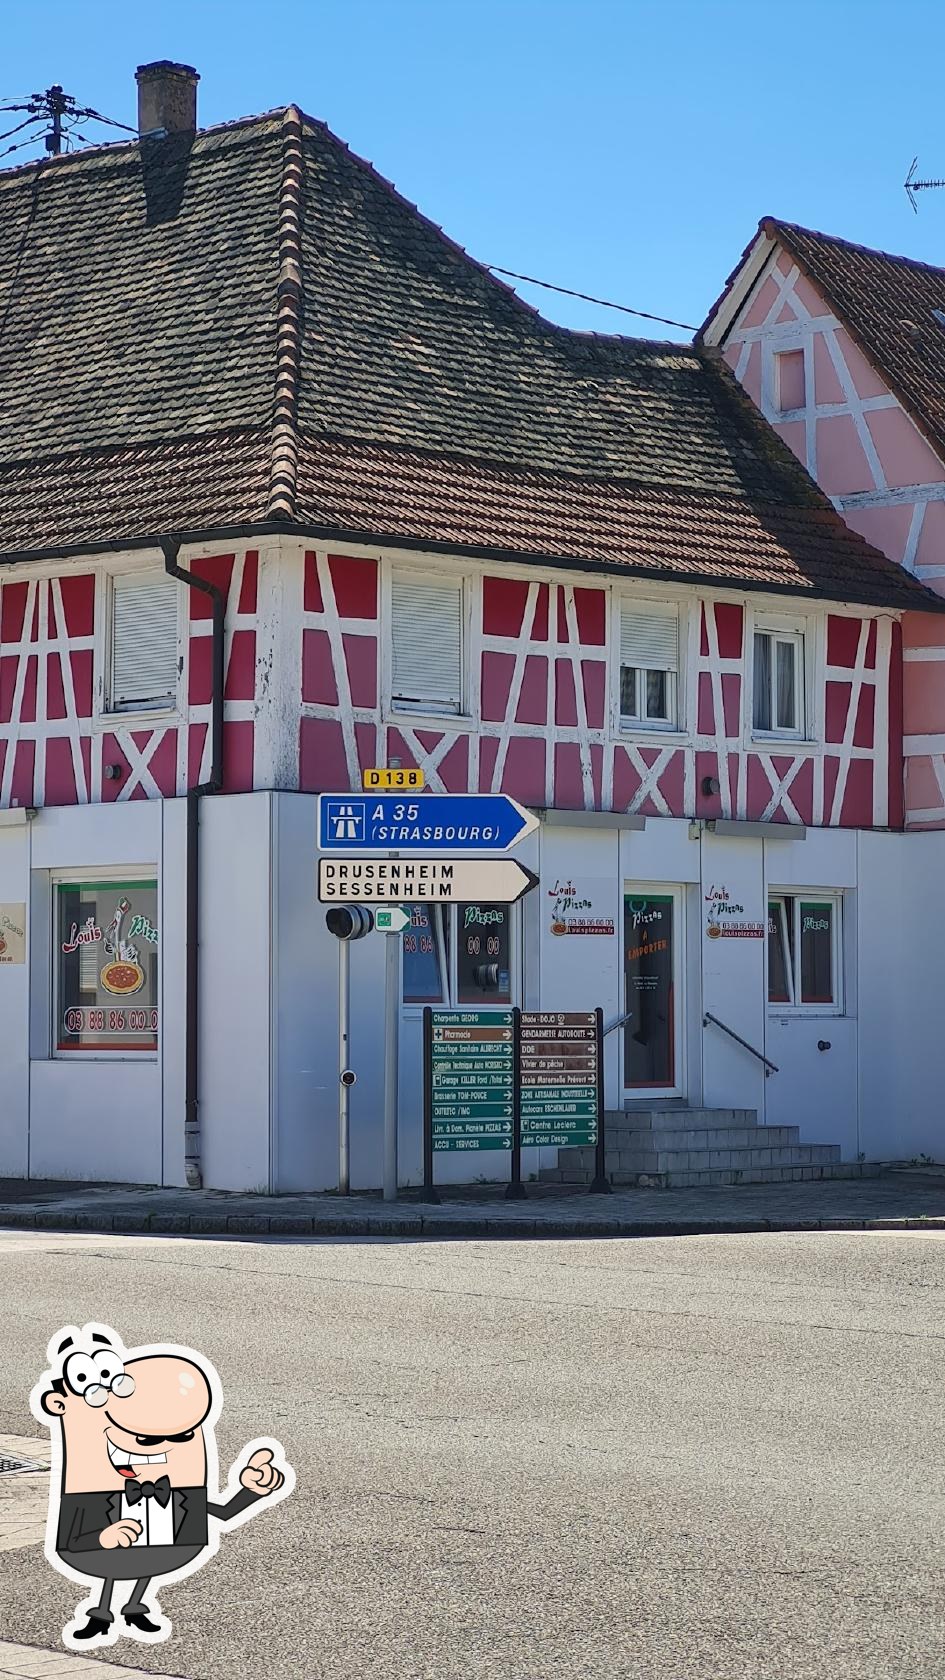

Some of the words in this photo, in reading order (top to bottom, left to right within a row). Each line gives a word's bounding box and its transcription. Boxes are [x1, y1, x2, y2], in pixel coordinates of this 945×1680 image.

[370, 773, 380, 785] D
[386, 773, 417, 785] 138
[372, 805, 385, 821] A
[392, 804, 419, 821] 35
[371, 826, 500, 840] (STRASBOURG)
[326, 865, 454, 878] DRUSENHEIM
[326, 882, 452, 896] SESSENHEIM
[548, 880, 577, 896] Louis
[705, 884, 730, 900] Louis
[562, 897, 592, 913] Pizzas
[717, 902, 744, 916] Pizzas
[410, 905, 428, 927] uis
[464, 906, 504, 929] Pizzas
[633, 911, 662, 930] Pizzas
[128, 914, 158, 944] Pizz
[803, 917, 828, 933] Pizzas
[62, 916, 101, 953] Louis
[628, 940, 667, 960] EMPORTER
[68, 1010, 82, 1030] 03
[88, 1010, 104, 1030] 88
[108, 1010, 124, 1030] 86
[129, 1010, 146, 1030] 00
[150, 1010, 158, 1030] 0
[434, 1014, 460, 1023] Charpente
[445, 1030, 471, 1038] Pharmacie
[522, 1030, 556, 1038] GENDARMERIE
[558, 1029, 586, 1038] AUTOROUTE
[442, 1076, 458, 1085] Garage
[456, 1140, 479, 1148] SERVICES
[551, 1135, 568, 1144] Design
